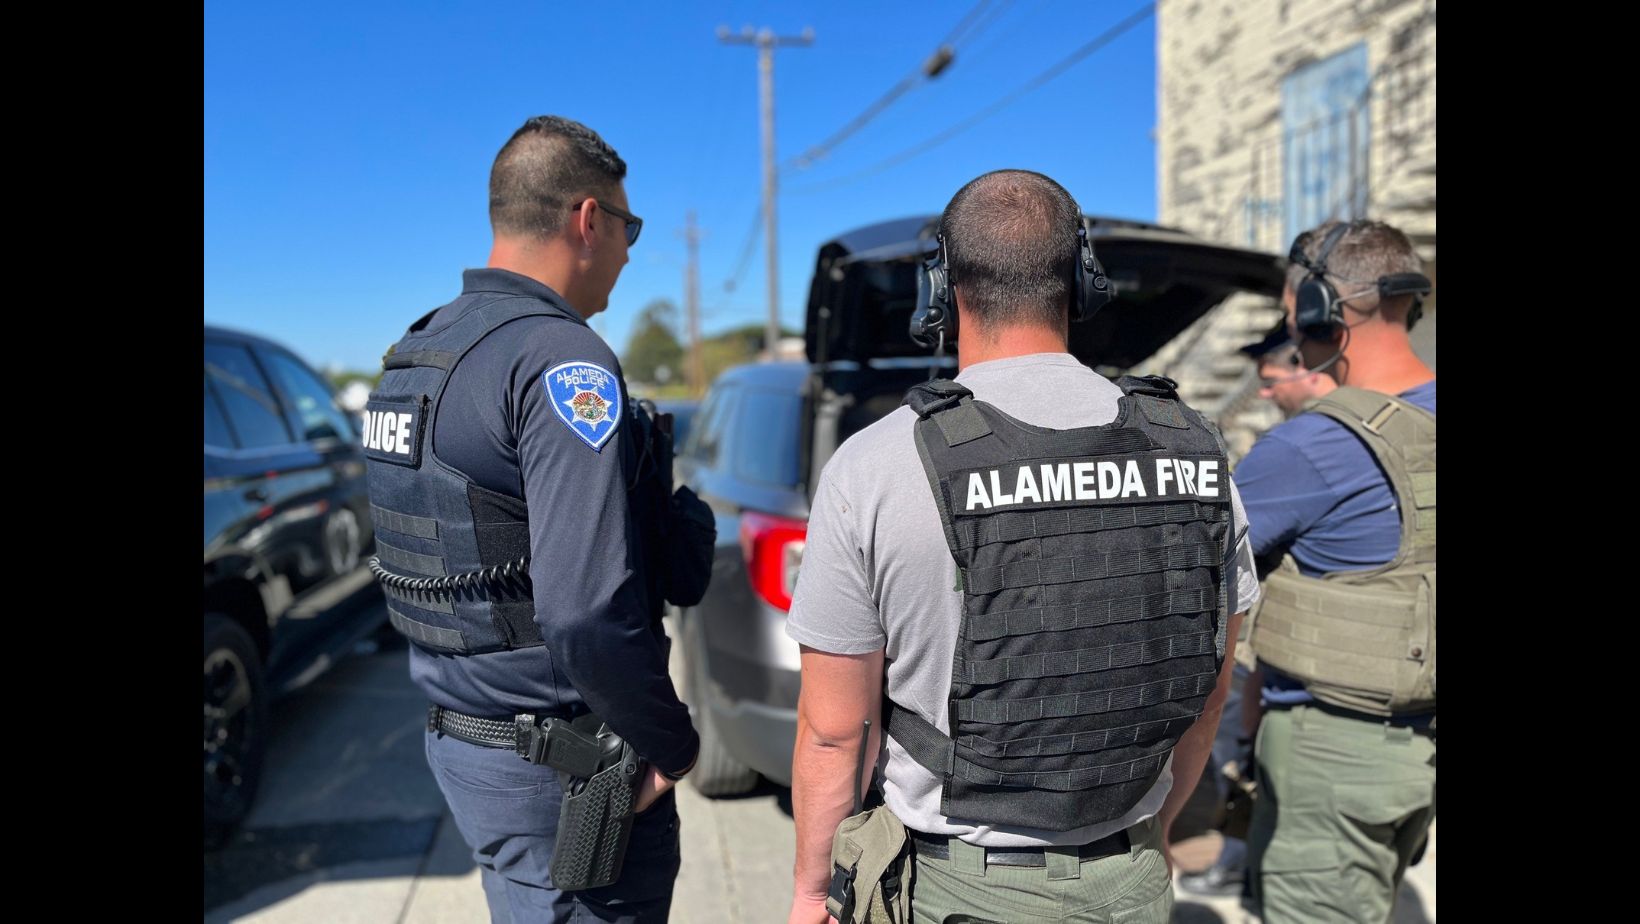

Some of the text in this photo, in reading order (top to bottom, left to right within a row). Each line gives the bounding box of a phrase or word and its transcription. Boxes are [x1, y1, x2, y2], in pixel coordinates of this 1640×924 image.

[556, 368, 610, 384] ALAMEDA
[565, 375, 606, 389] POLICE
[362, 410, 413, 455] OLICE
[965, 458, 1219, 511] ALAMEDA FIRE
